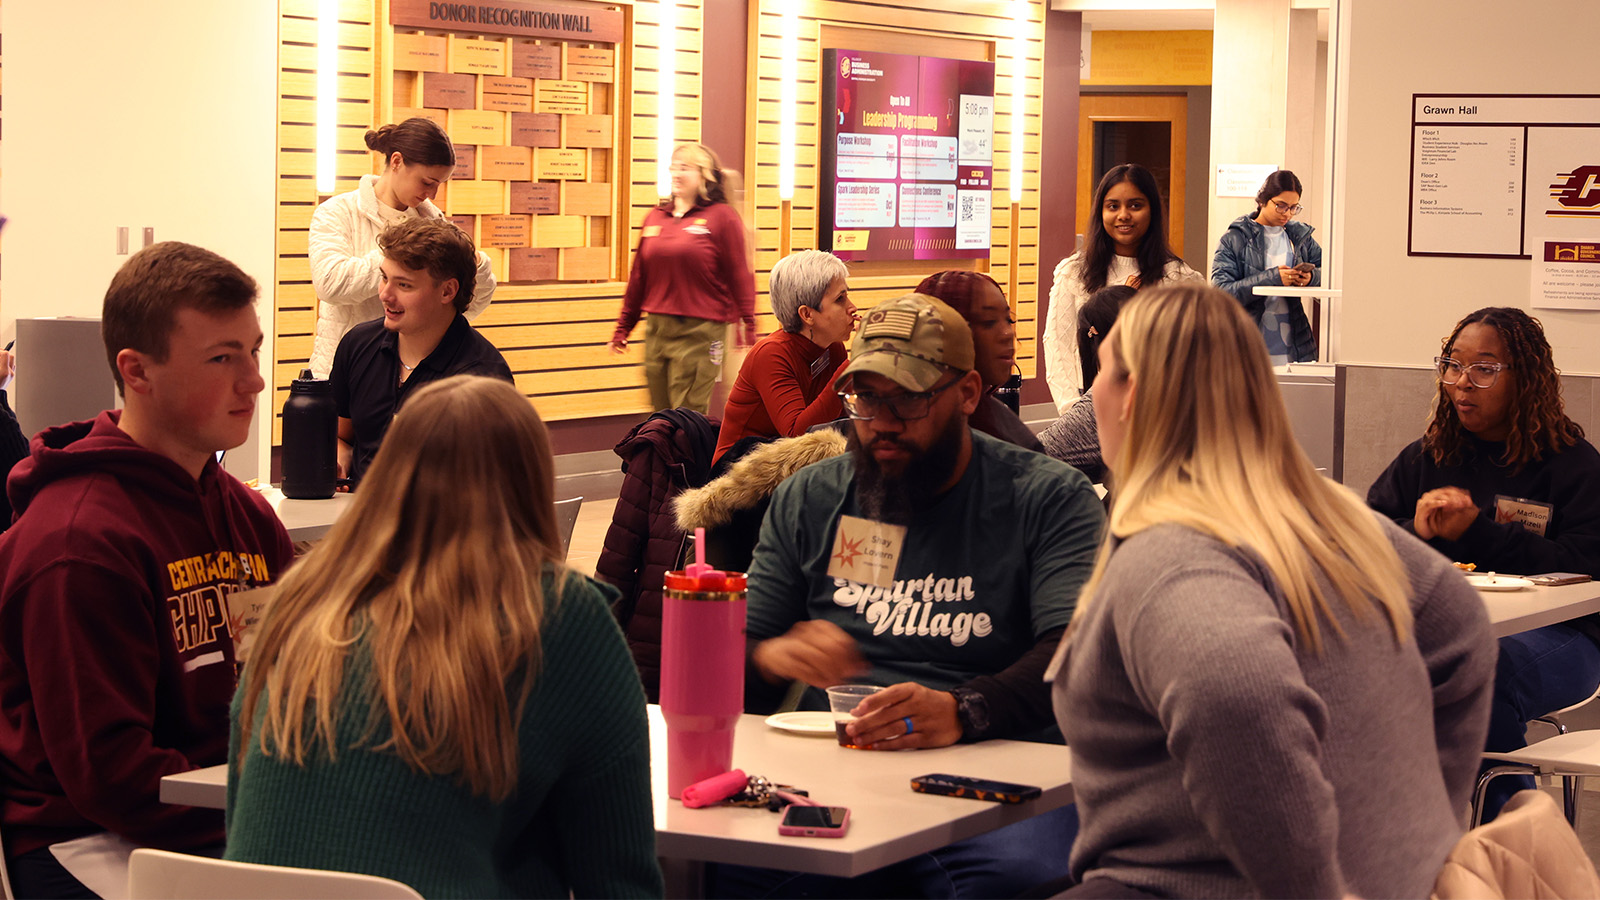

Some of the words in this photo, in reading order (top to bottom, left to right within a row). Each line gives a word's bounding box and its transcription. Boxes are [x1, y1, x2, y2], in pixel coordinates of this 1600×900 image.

[429, 2, 477, 23] DONOR
[478, 7, 560, 30] RECOGNITION
[561, 14, 593, 33] WALL
[890, 95, 900, 107] Open
[900, 96, 905, 106] To
[965, 102, 978, 115] 5:08
[979, 106, 988, 118] pm
[1423, 105, 1454, 115] Grawn
[1459, 106, 1478, 114] Hall
[862, 110, 897, 130] Leadership
[898, 112, 938, 132] Programming
[838, 135, 853, 145] Purpose
[854, 136, 871, 146] Workshop
[921, 138, 938, 149] Workshop
[838, 185, 848, 195] Spark
[849, 185, 868, 195] Leadership
[869, 185, 880, 194] Series
[902, 186, 922, 195] Connections
[923, 187, 942, 196] Conference
[1516, 508, 1548, 520] Madison
[832, 572, 975, 614] Spartan
[866, 597, 993, 647] Village
